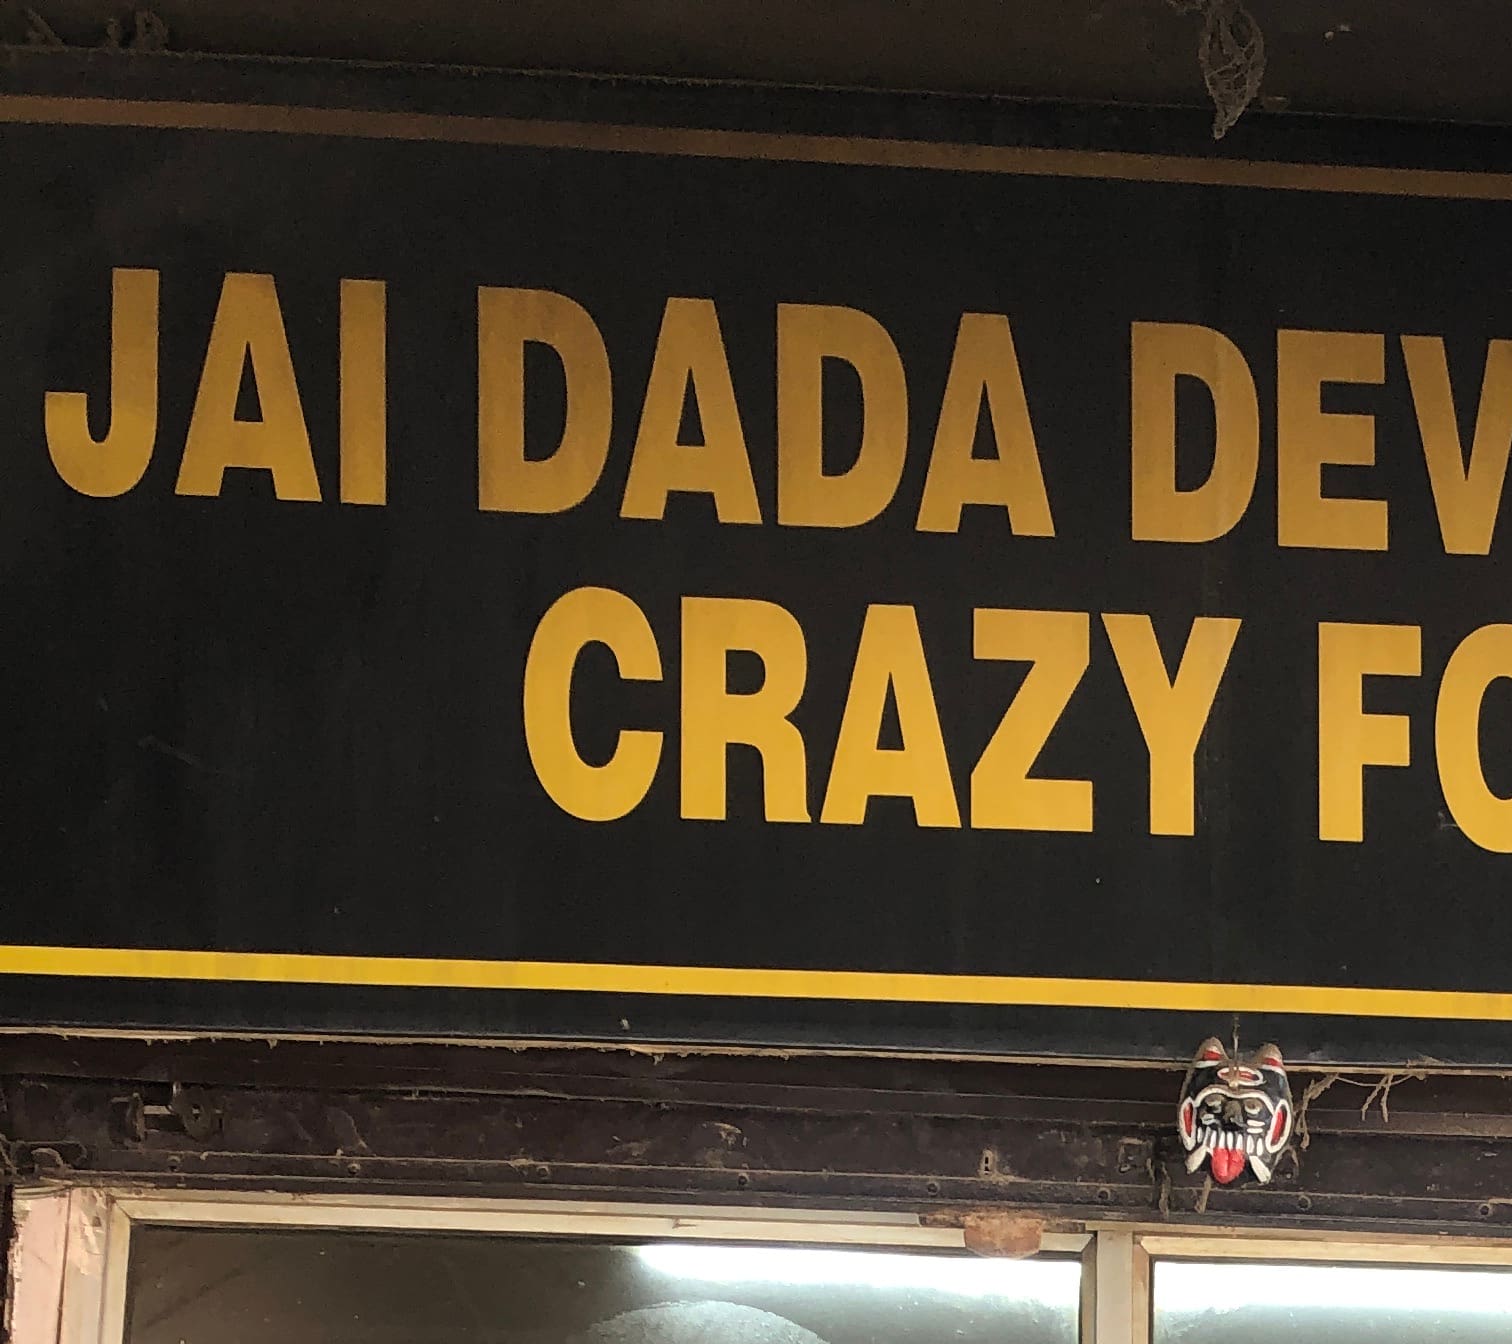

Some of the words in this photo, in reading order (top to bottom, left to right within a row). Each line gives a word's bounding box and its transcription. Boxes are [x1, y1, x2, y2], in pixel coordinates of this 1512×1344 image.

[45, 267, 387, 506] JAI
[477, 285, 1055, 538] DADA
[523, 585, 1241, 837] CRAZY
